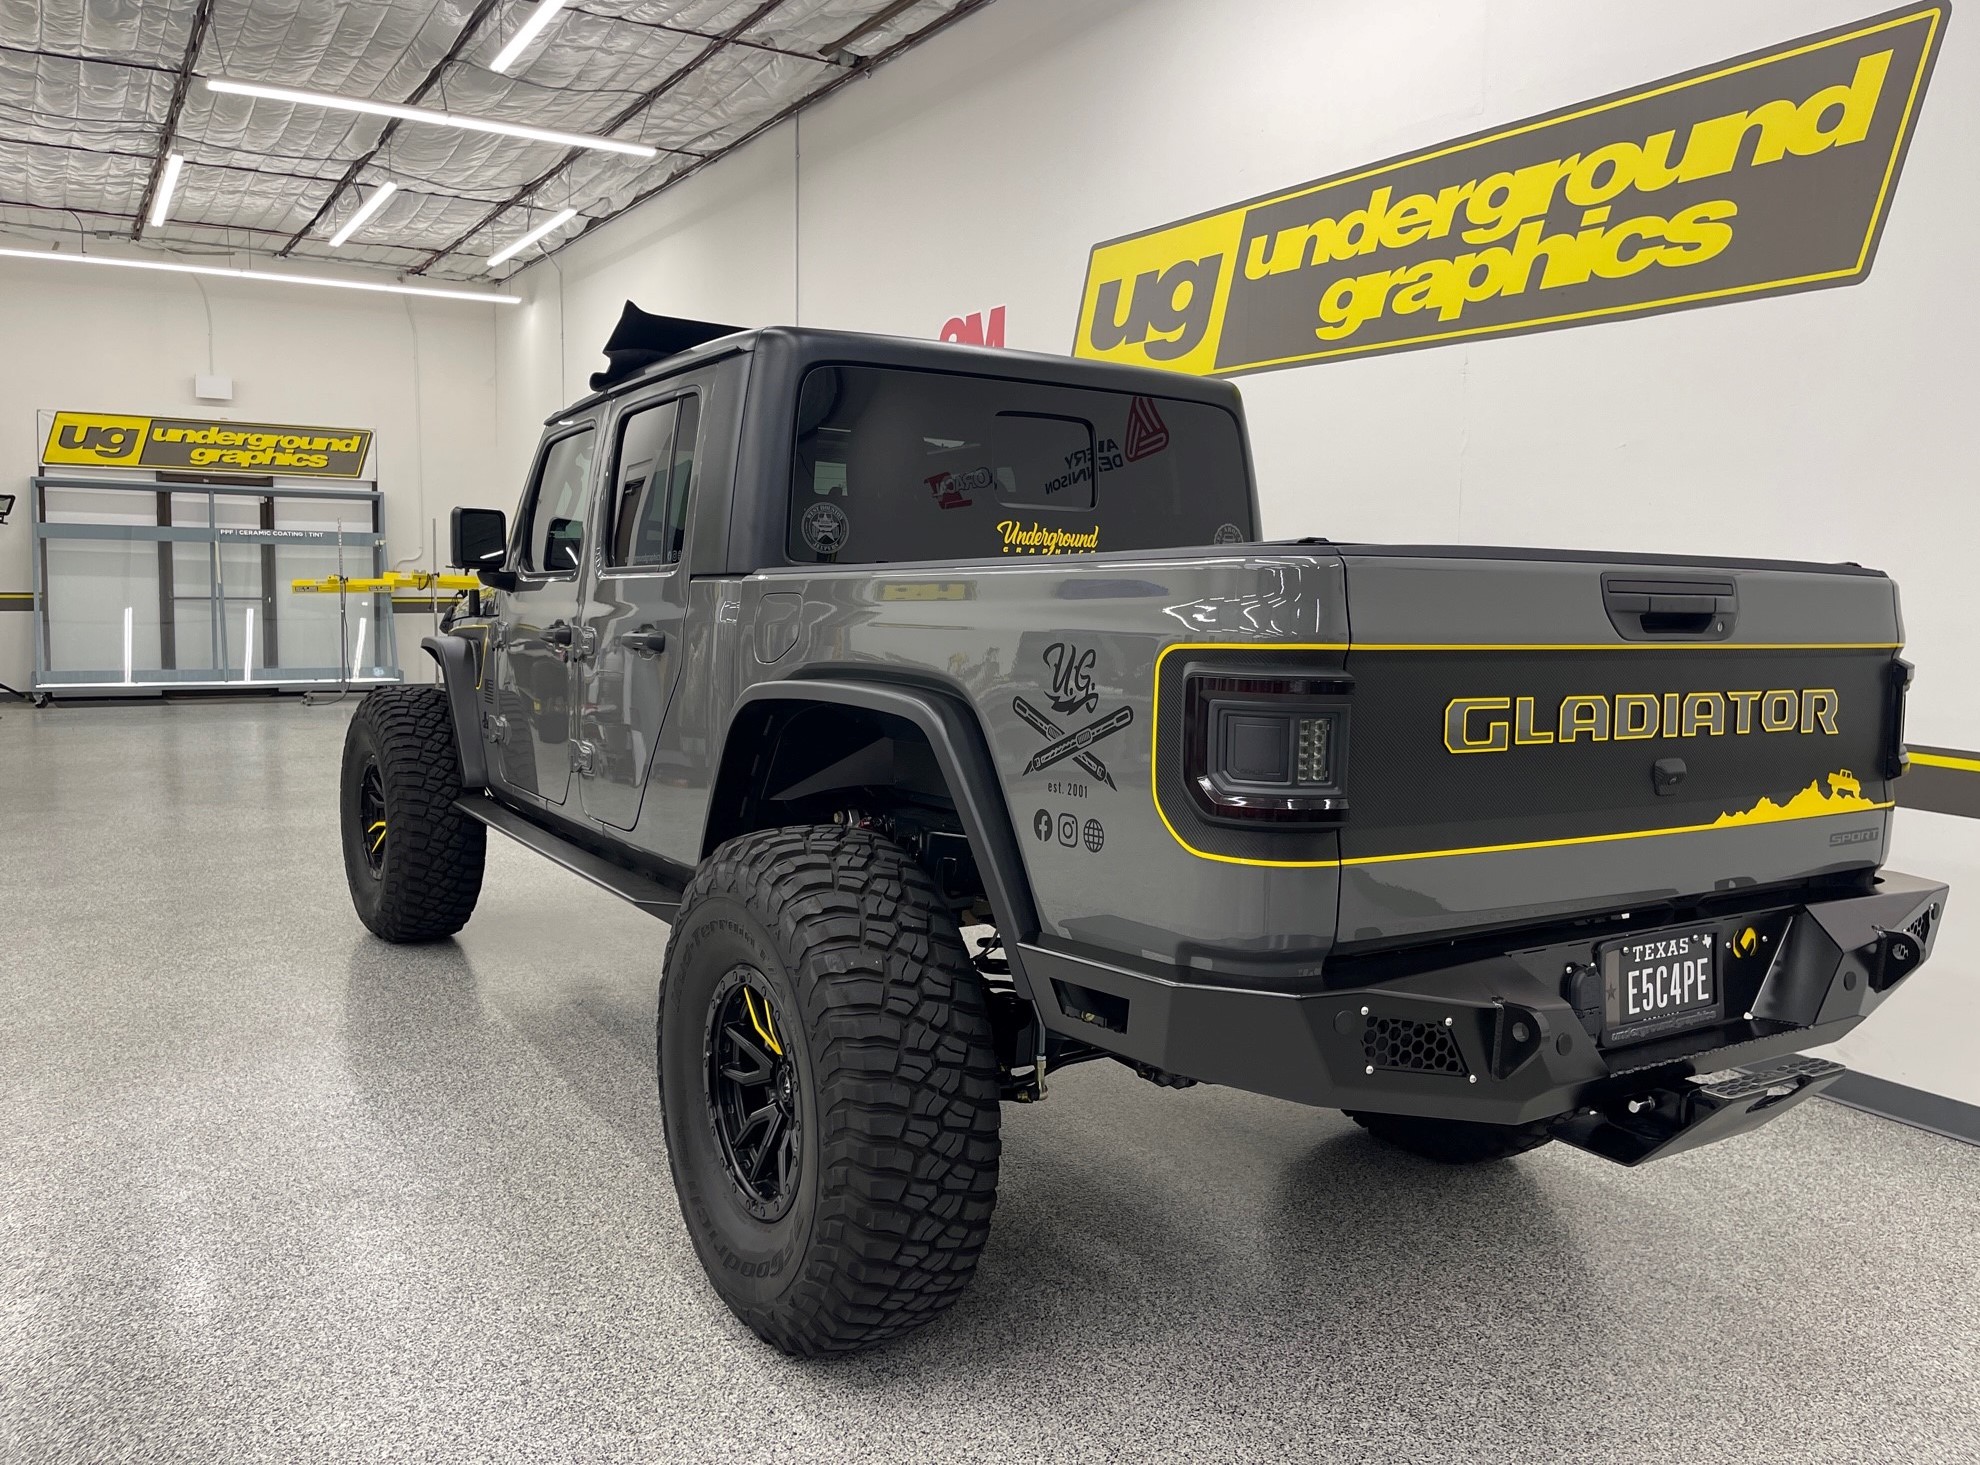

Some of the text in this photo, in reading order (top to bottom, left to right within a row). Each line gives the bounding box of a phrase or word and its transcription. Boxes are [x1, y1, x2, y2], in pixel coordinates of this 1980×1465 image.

[1245, 49, 1895, 280] underground
[1315, 200, 1738, 341] graphics
[1090, 253, 1223, 360] ug
[58, 426, 138, 458] ug
[152, 427, 360, 452] underground
[190, 448, 328, 467] graphics
[996, 520, 1099, 555] Underground
[1444, 689, 1839, 753] GLADIATOR
[1048, 782, 1089, 799] est. 2001
[1831, 829, 1880, 844] SPORT
[1633, 938, 1690, 962] TEXAS
[1627, 957, 1711, 1016] E5C4PE
